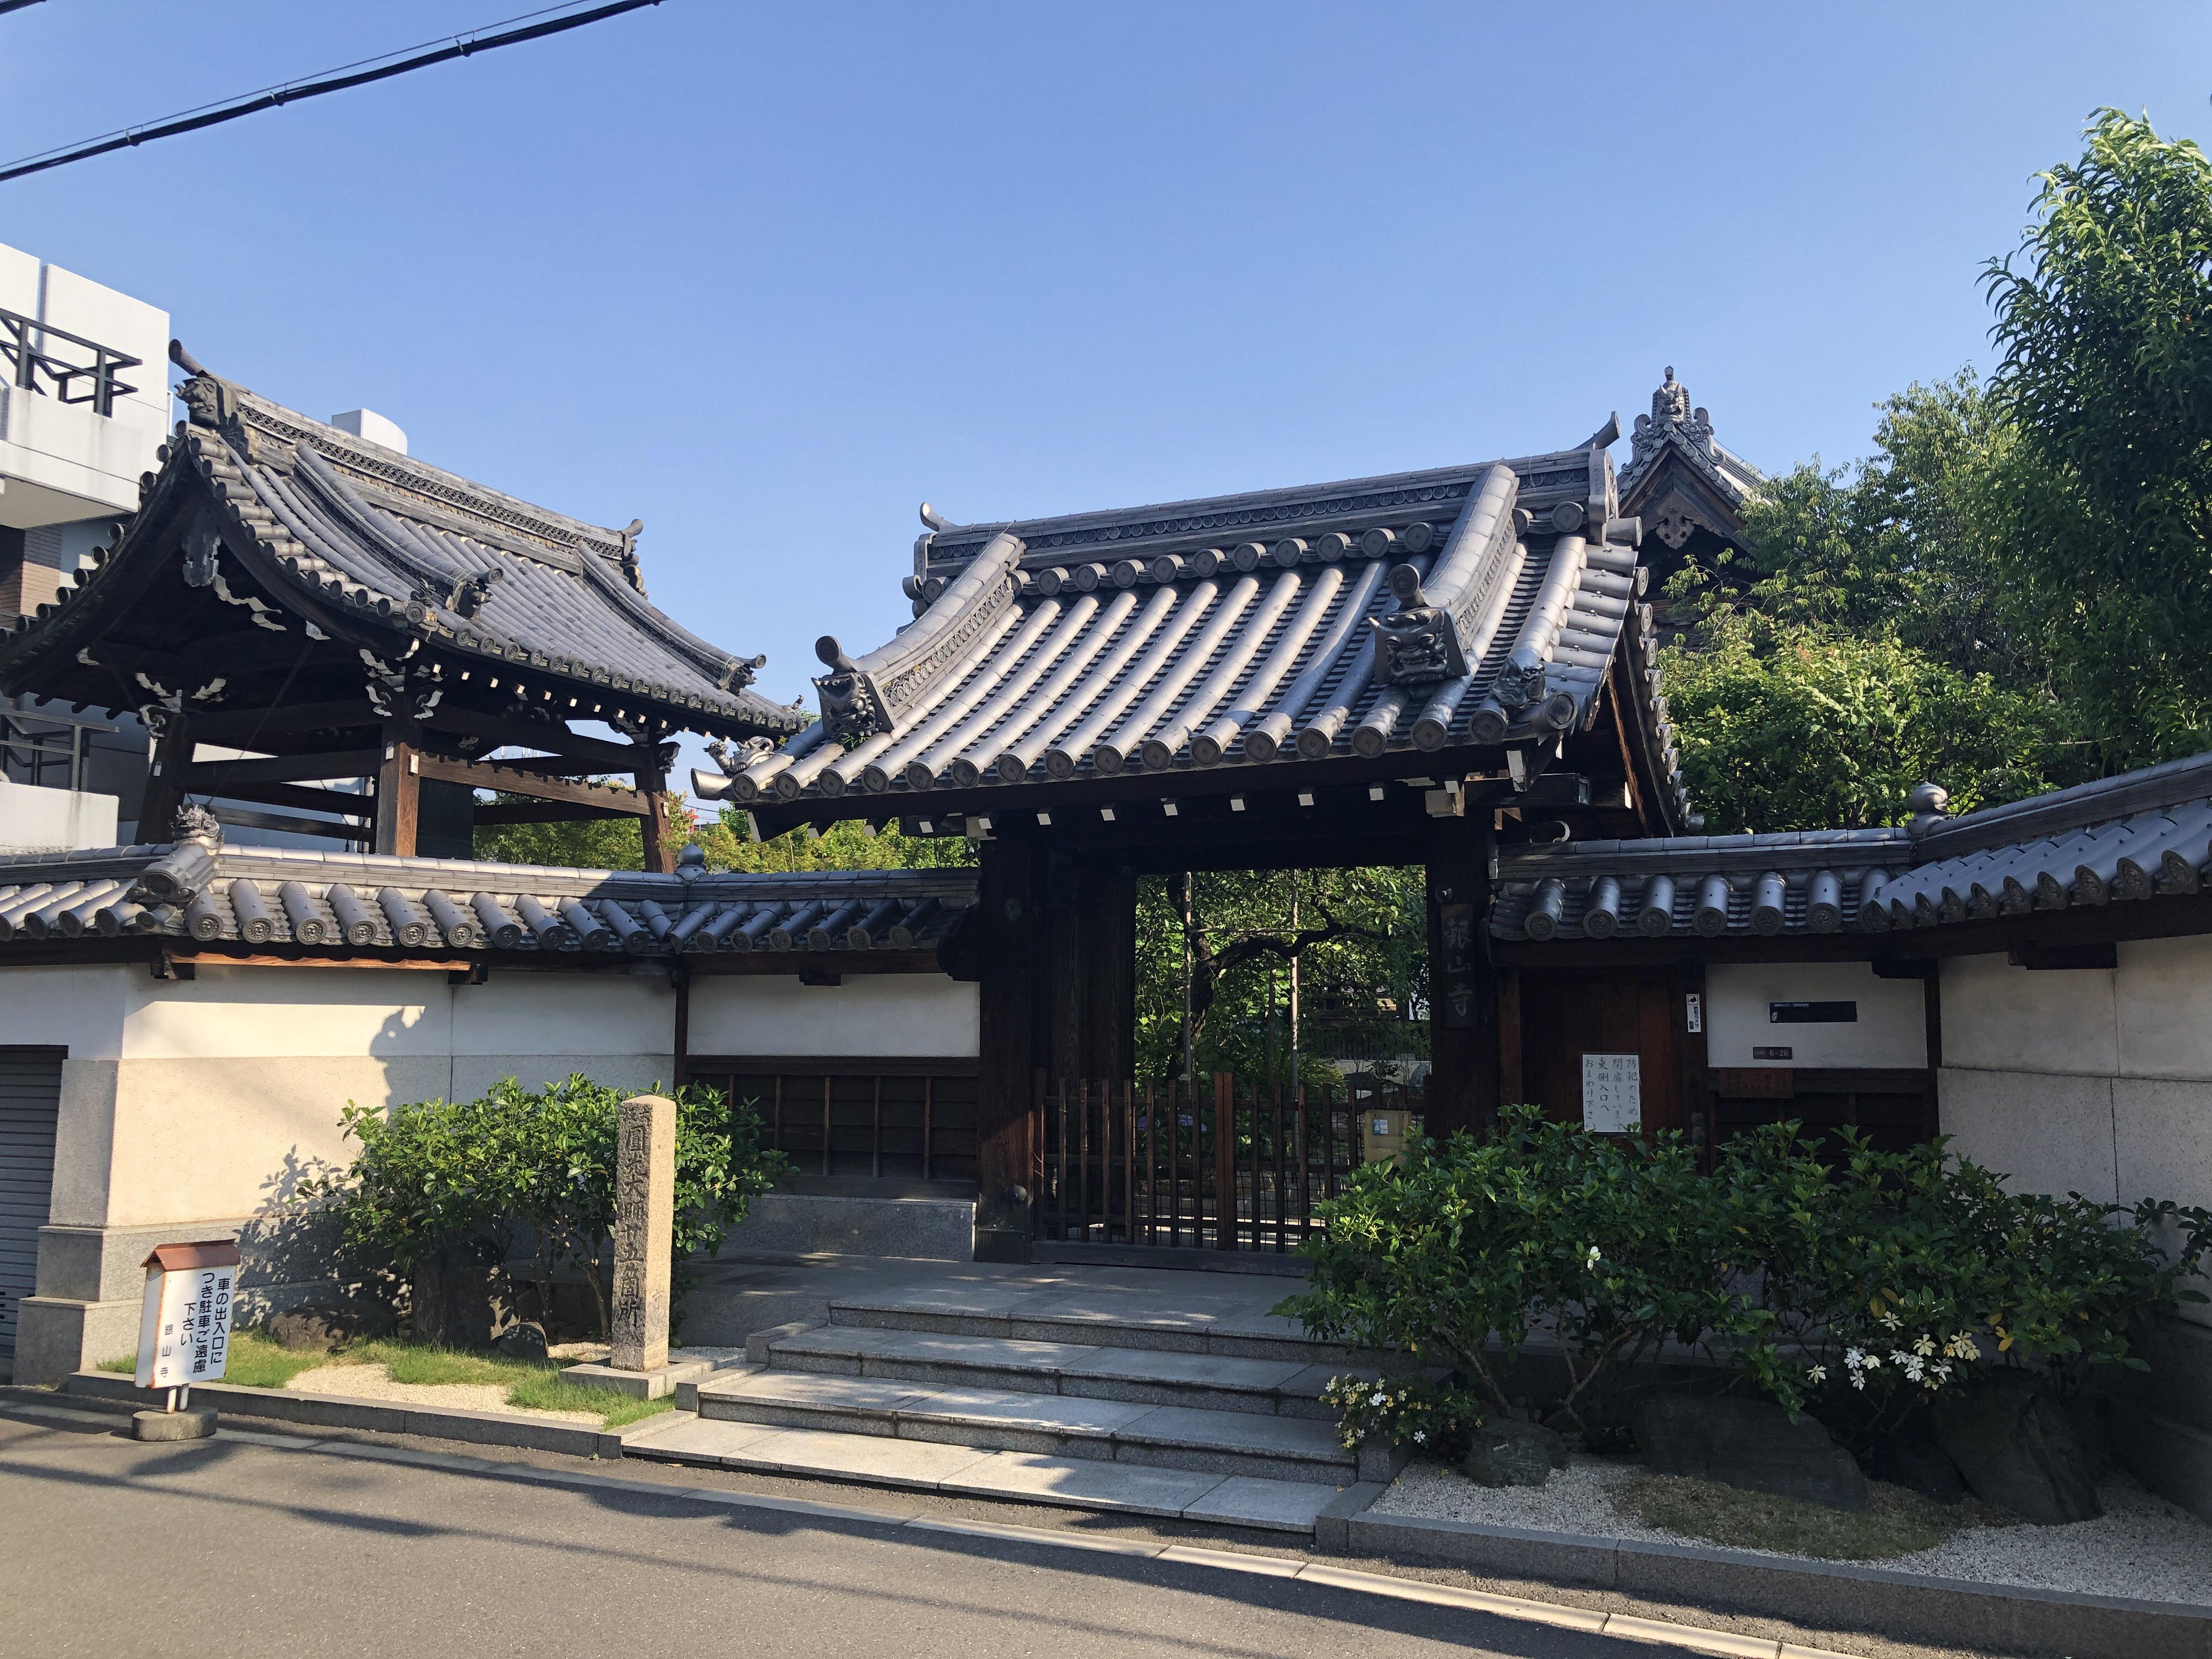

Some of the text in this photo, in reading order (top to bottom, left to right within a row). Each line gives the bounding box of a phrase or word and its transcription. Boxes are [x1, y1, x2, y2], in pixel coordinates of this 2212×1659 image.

[1598, 1057, 1610, 1111] 東側入口へ
[1626, 1058, 1638, 1116] 防犯のため
[181, 1302, 196, 1345] 下さい
[193, 1272, 215, 1374] つき駐車ご遠慮
[210, 1278, 230, 1364] 車の出入口に
[160, 1324, 173, 1378] 銀山寺
